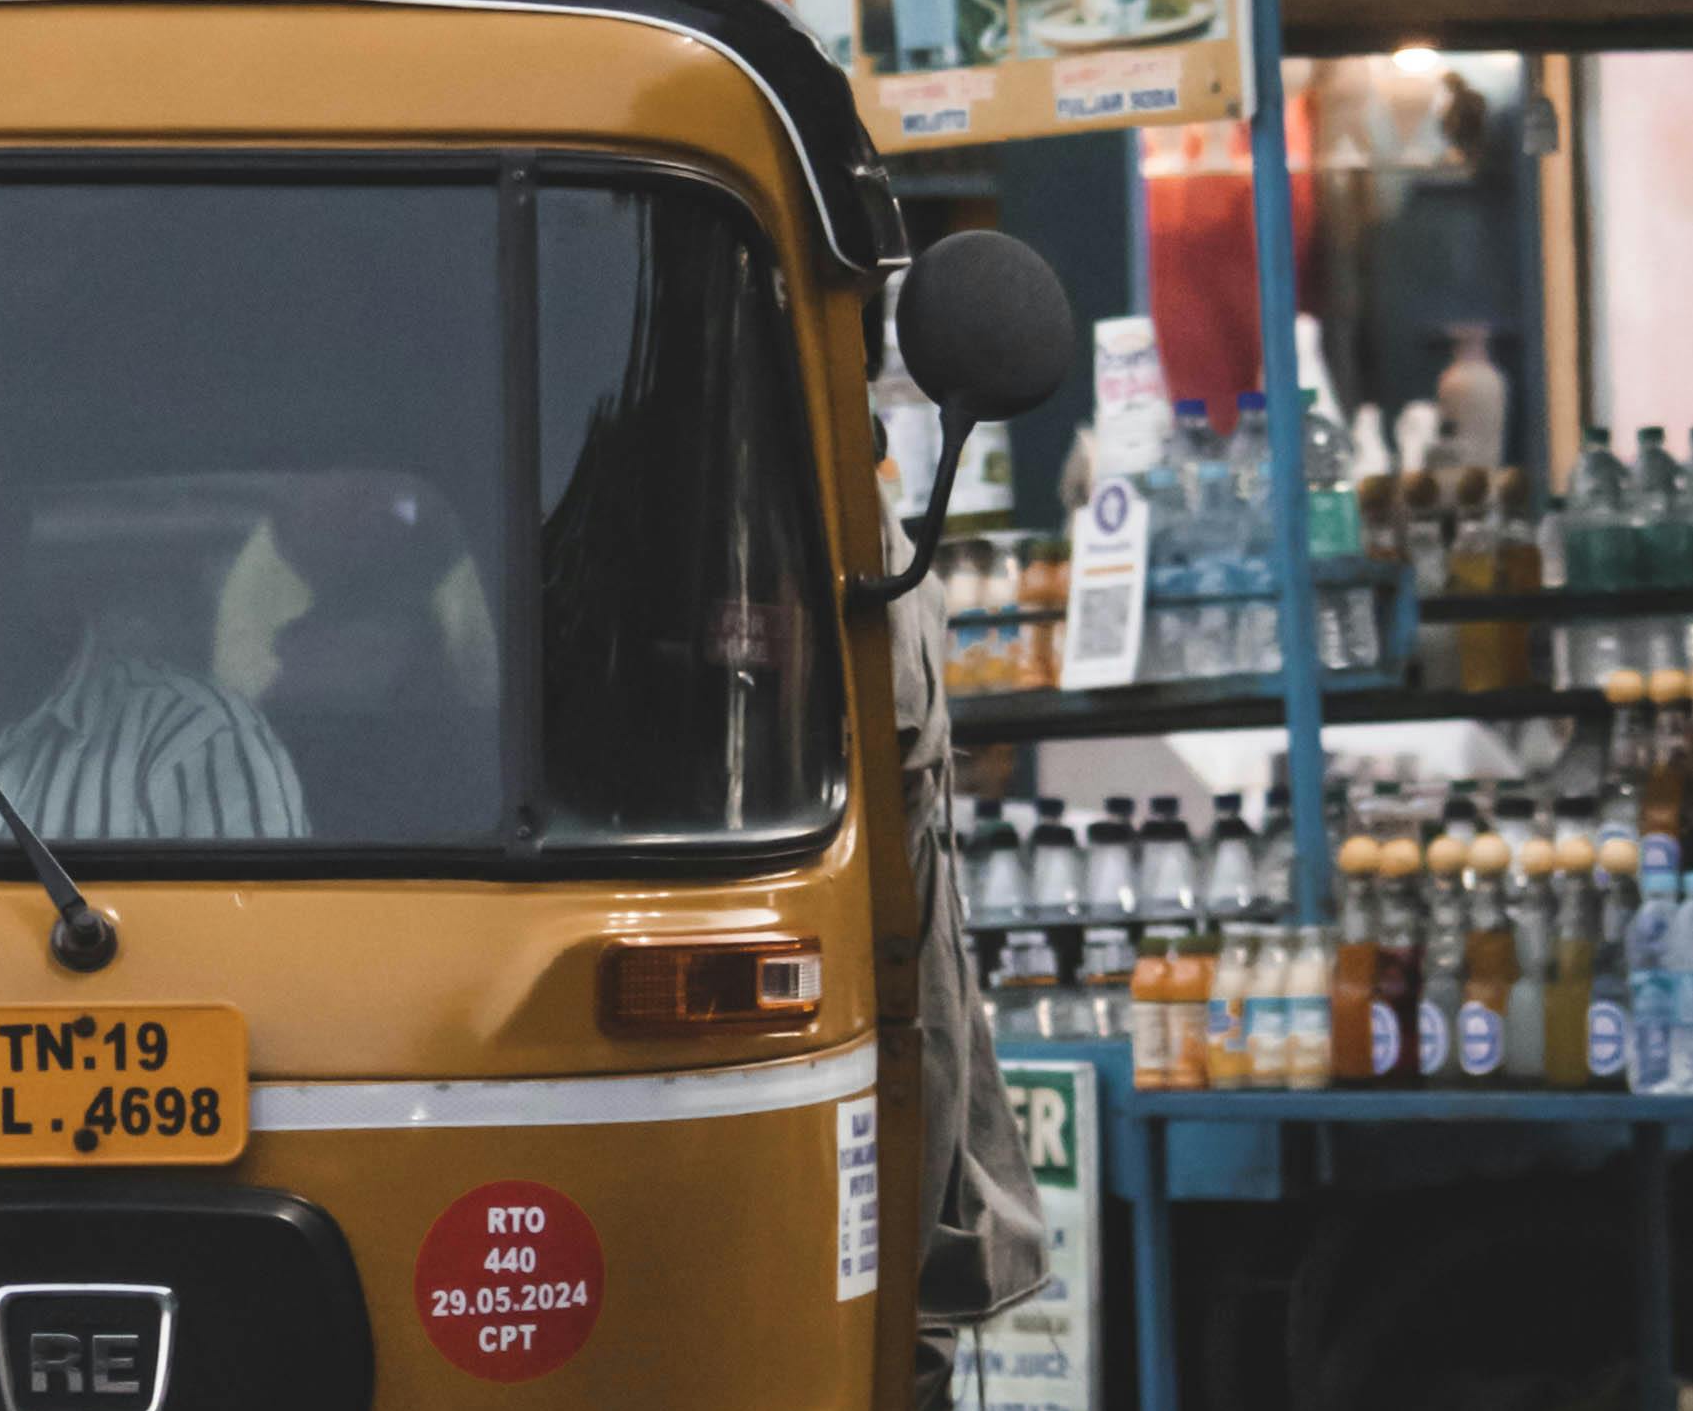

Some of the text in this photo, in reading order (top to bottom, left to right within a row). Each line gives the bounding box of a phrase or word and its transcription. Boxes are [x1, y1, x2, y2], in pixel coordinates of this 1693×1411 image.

[487, 1206, 546, 1234] RTO
[483, 1246, 536, 1274] 440
[431, 1280, 588, 1317] 29.05.2024
[478, 1324, 537, 1352] CPT
[30, 1332, 140, 1393] RE
